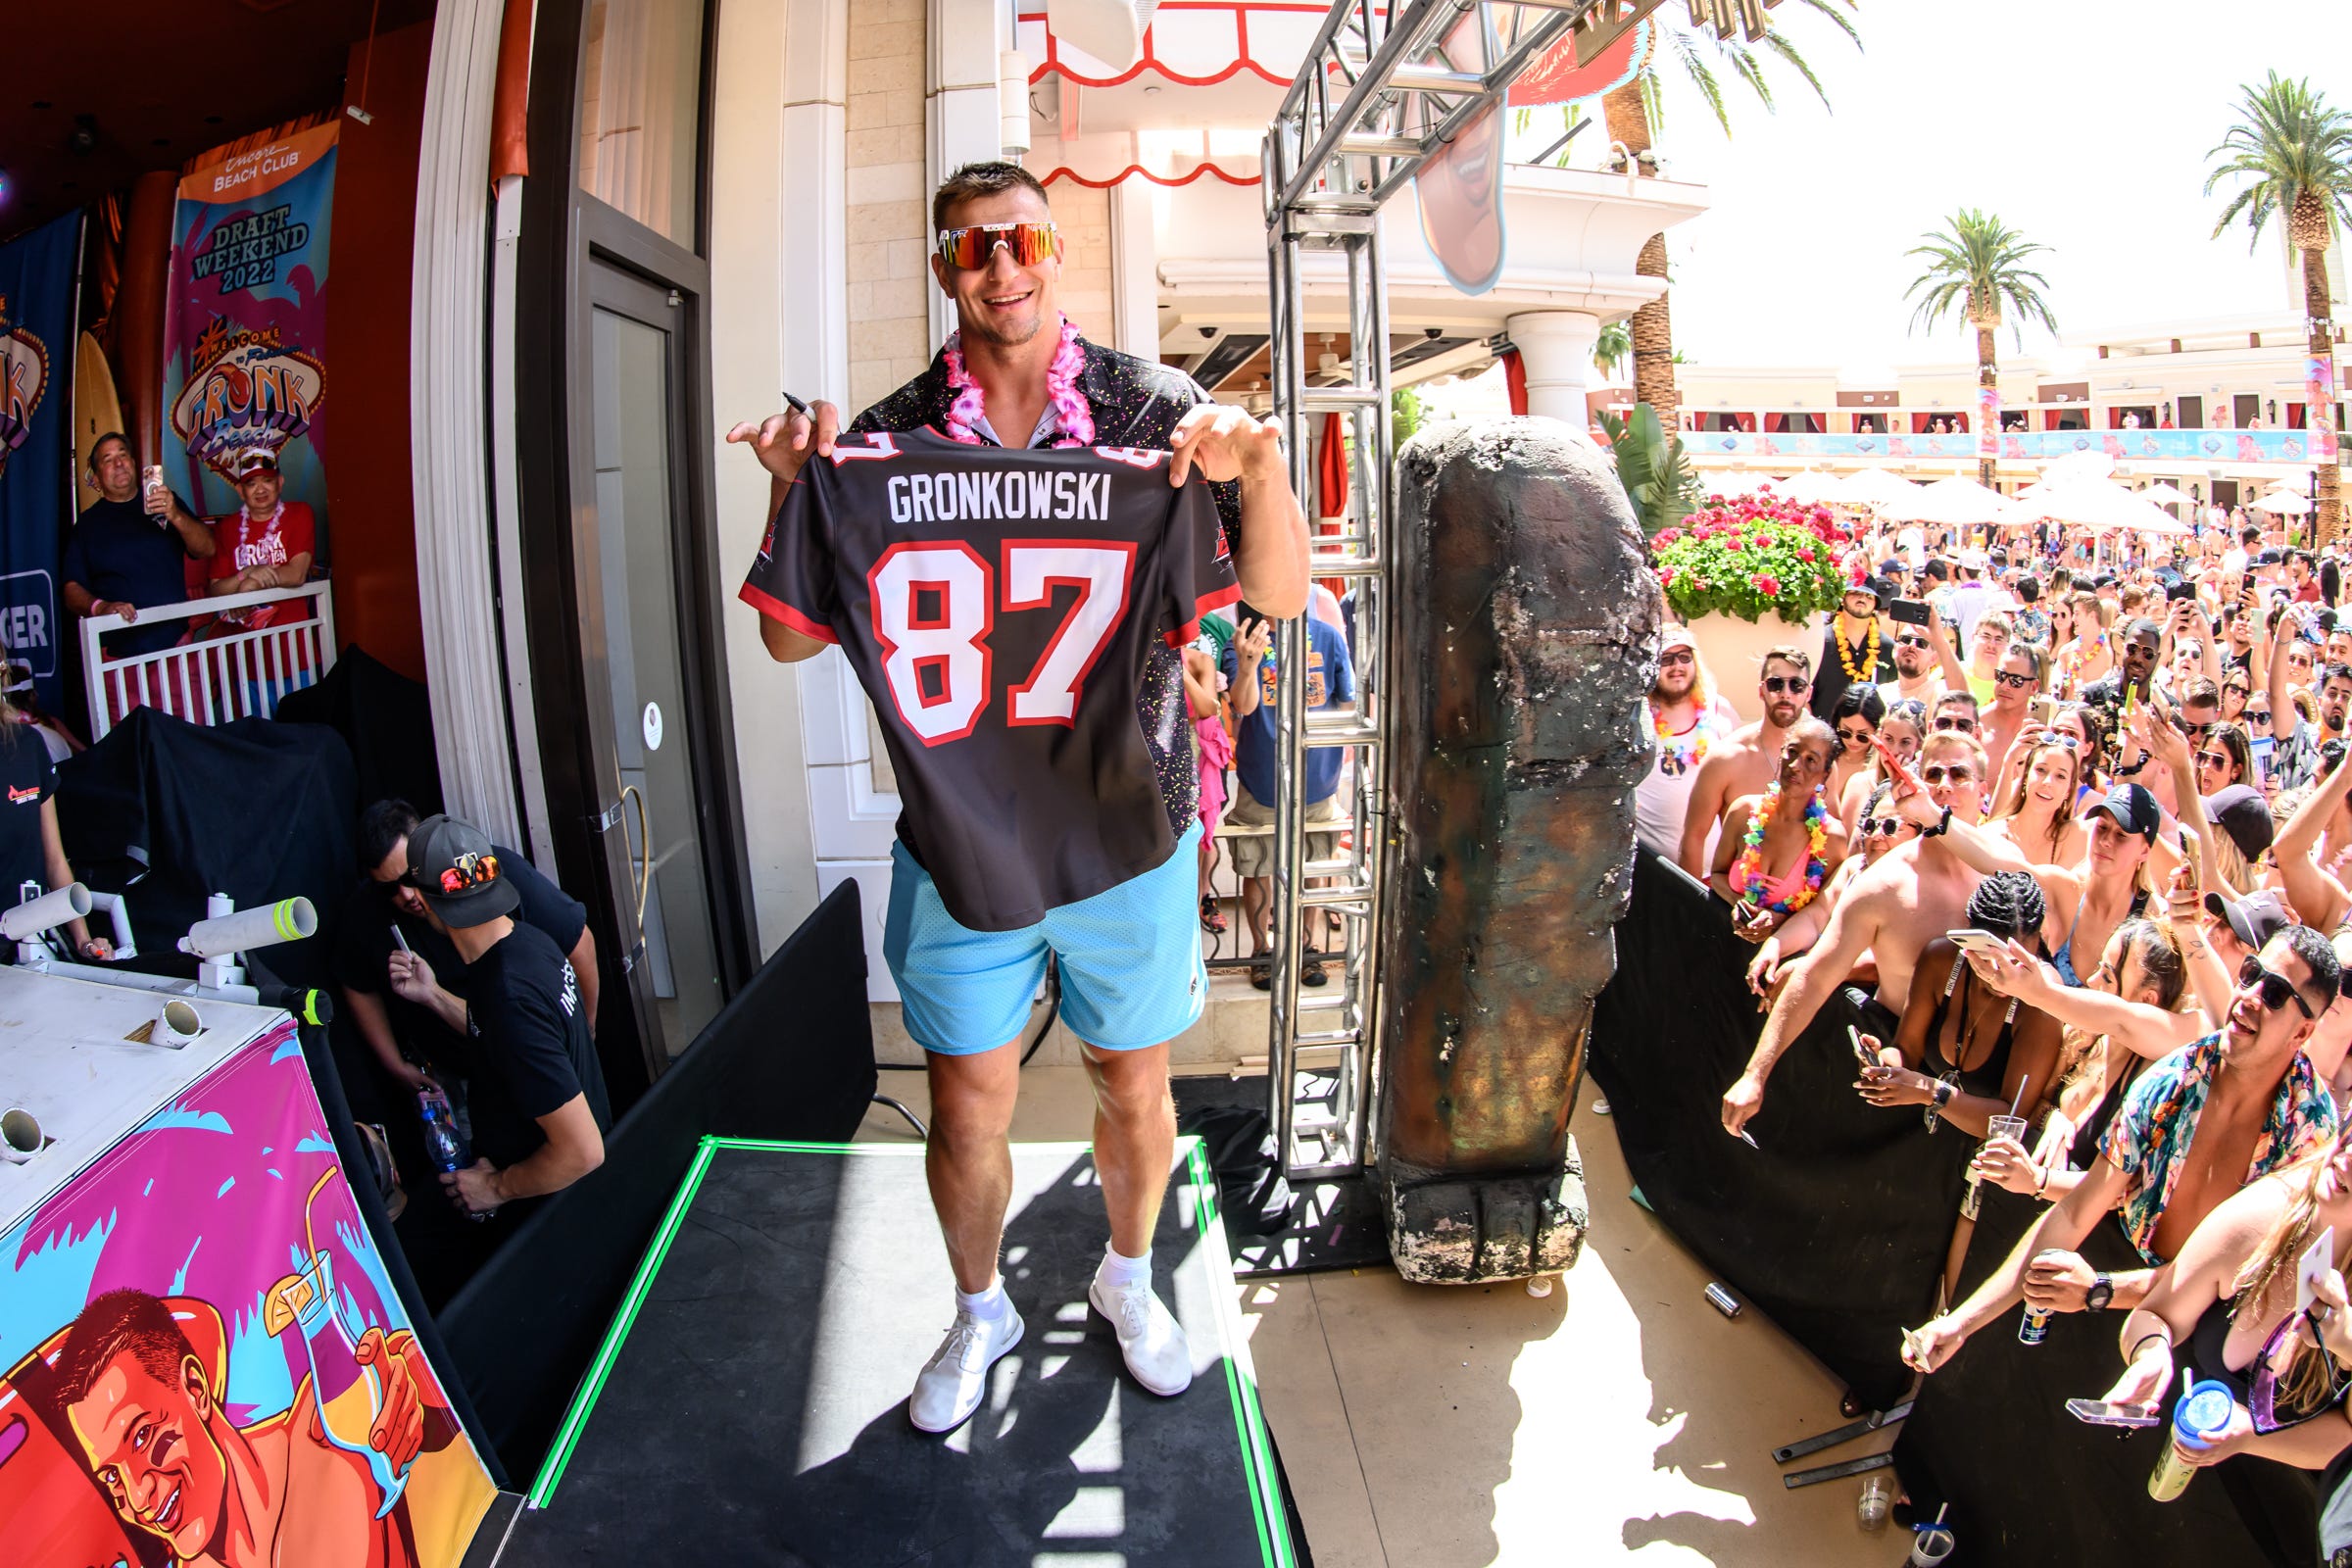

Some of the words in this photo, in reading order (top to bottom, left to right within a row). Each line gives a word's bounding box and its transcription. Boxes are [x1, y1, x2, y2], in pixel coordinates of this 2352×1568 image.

[214, 166, 257, 192] BEACH
[262, 152, 298, 174] CLUB
[225, 145, 289, 172] Encore
[214, 206, 290, 250] DRAFT
[194, 223, 308, 278] WEEKEND
[222, 259, 274, 294] 2022
[210, 327, 280, 352] WELCOME
[202, 417, 285, 462] Beach
[888, 471, 1111, 523] GRONKOWSKI
[866, 538, 1139, 748] 87
